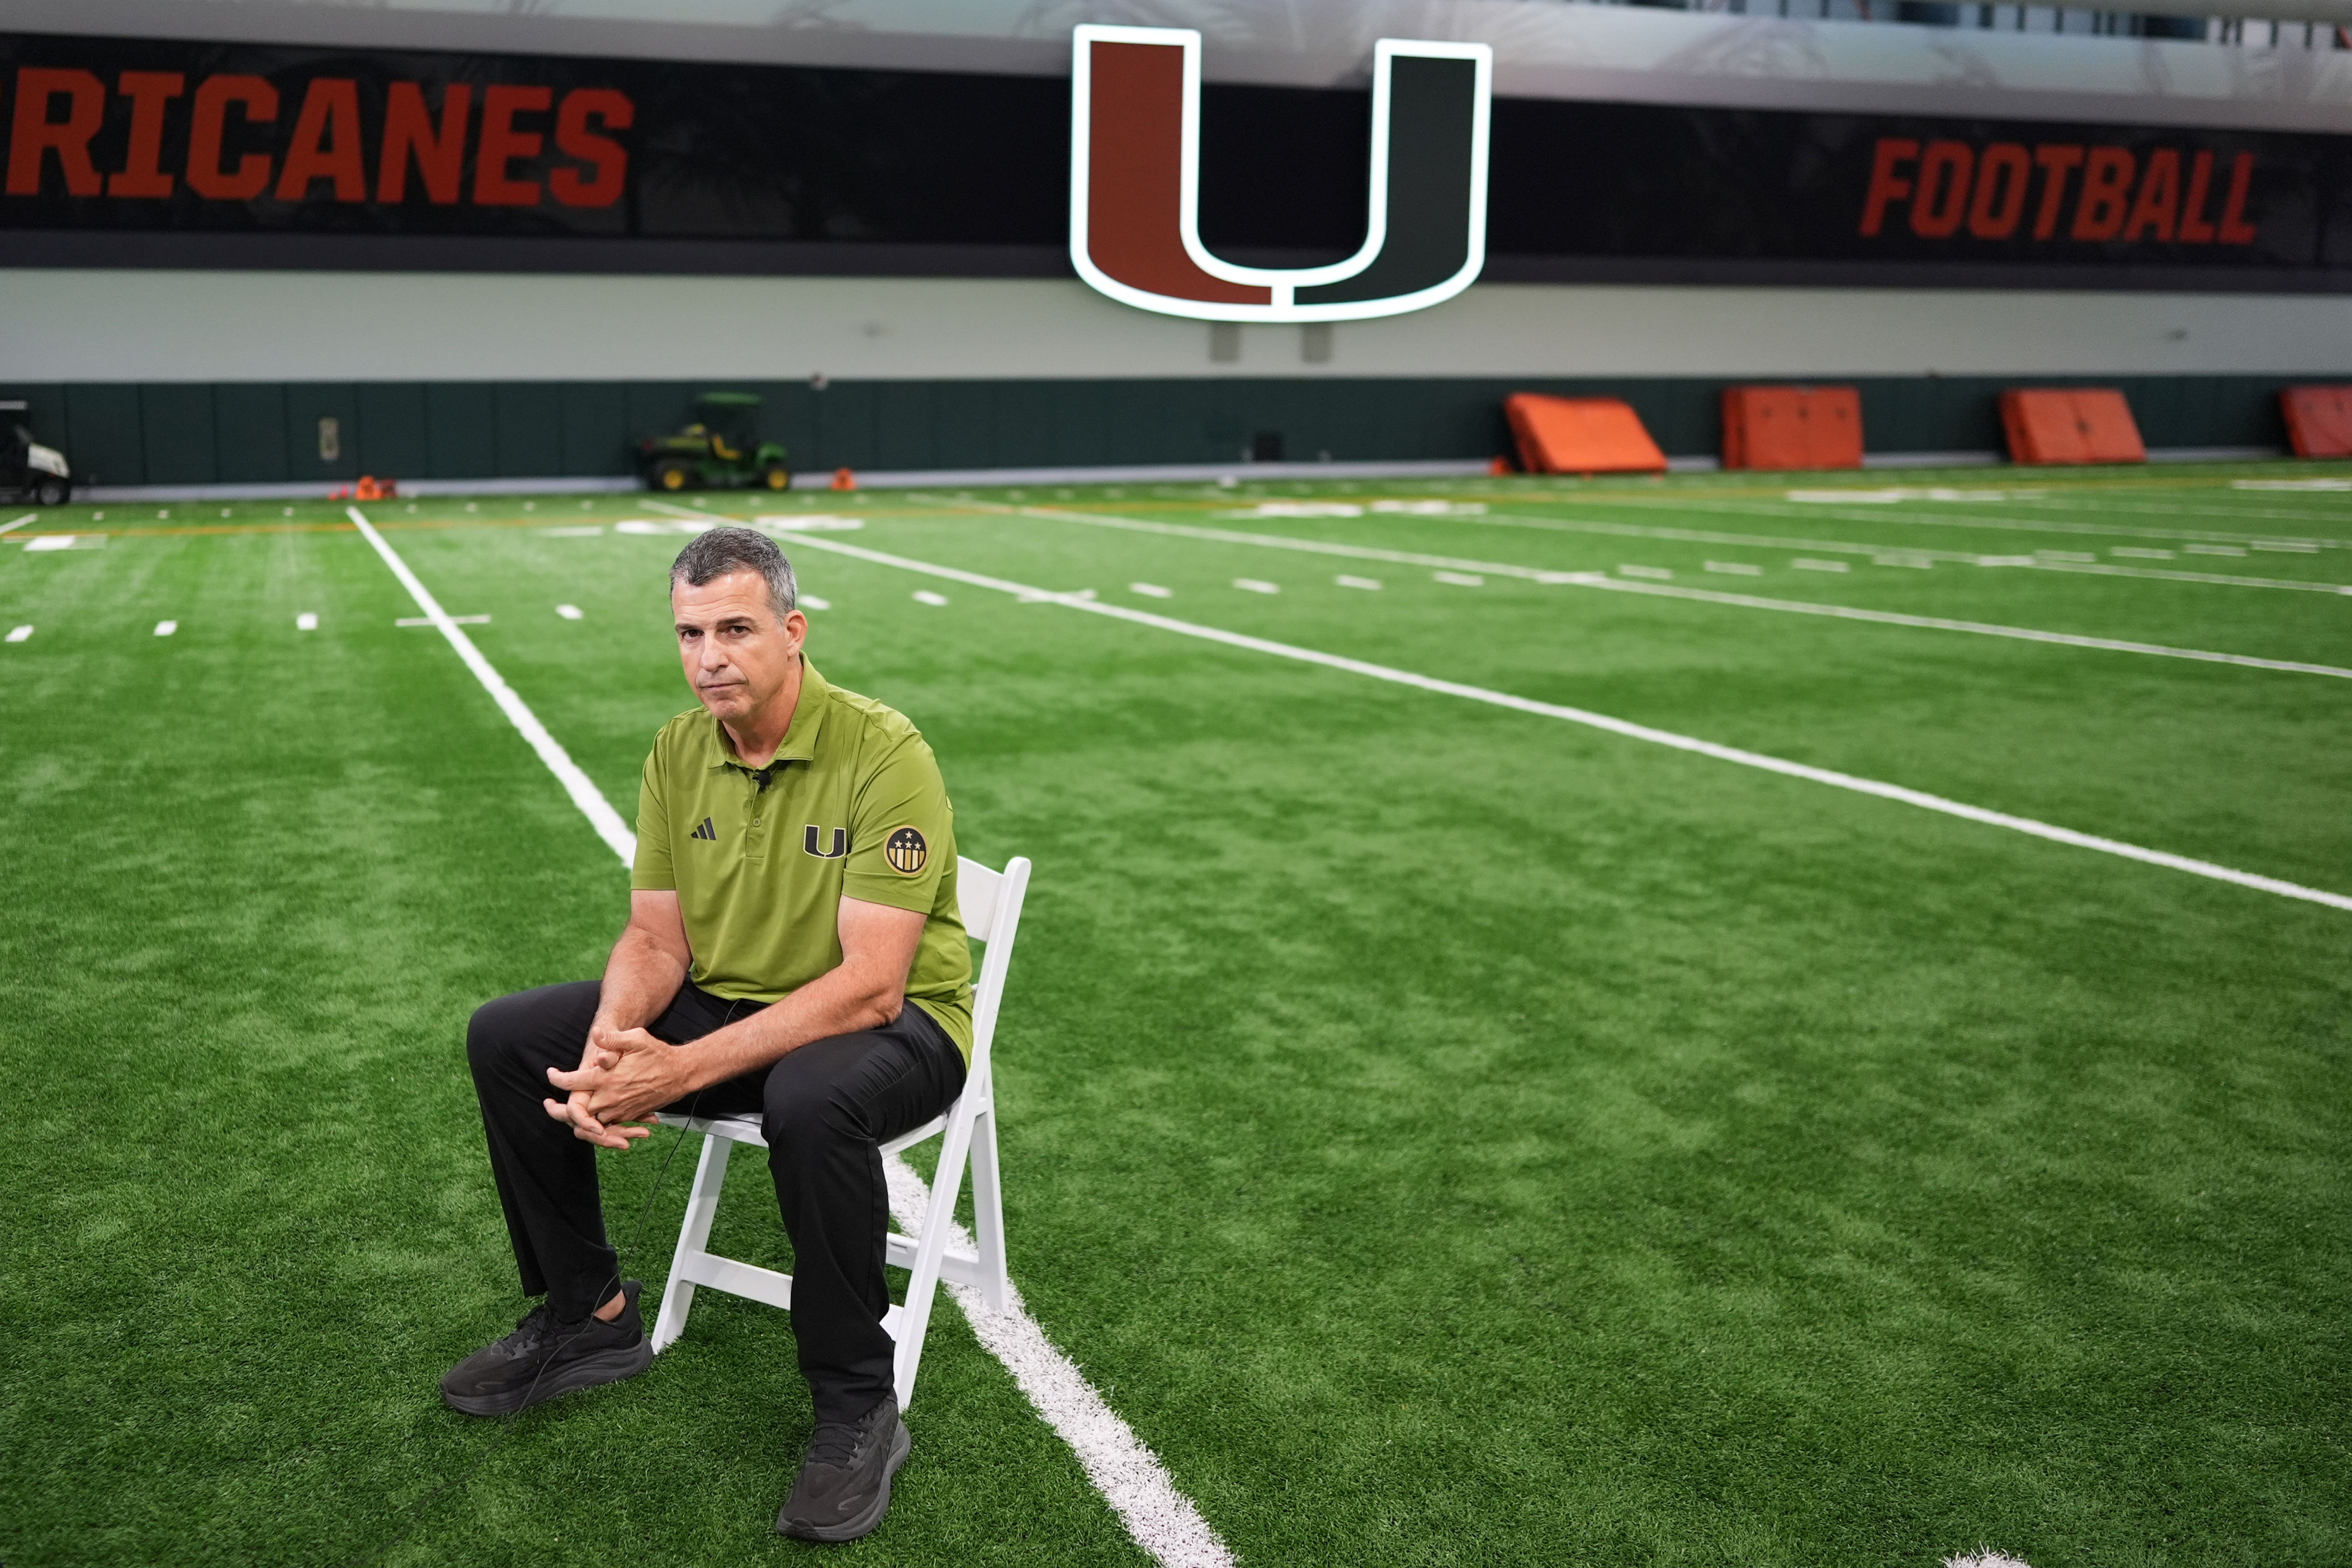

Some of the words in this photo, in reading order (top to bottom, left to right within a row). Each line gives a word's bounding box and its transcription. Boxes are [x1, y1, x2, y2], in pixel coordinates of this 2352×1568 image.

[0, 67, 635, 208] RICANES
[1069, 23, 1493, 323] U
[1858, 137, 2259, 244] FOOTBALL
[803, 824, 847, 860] U
